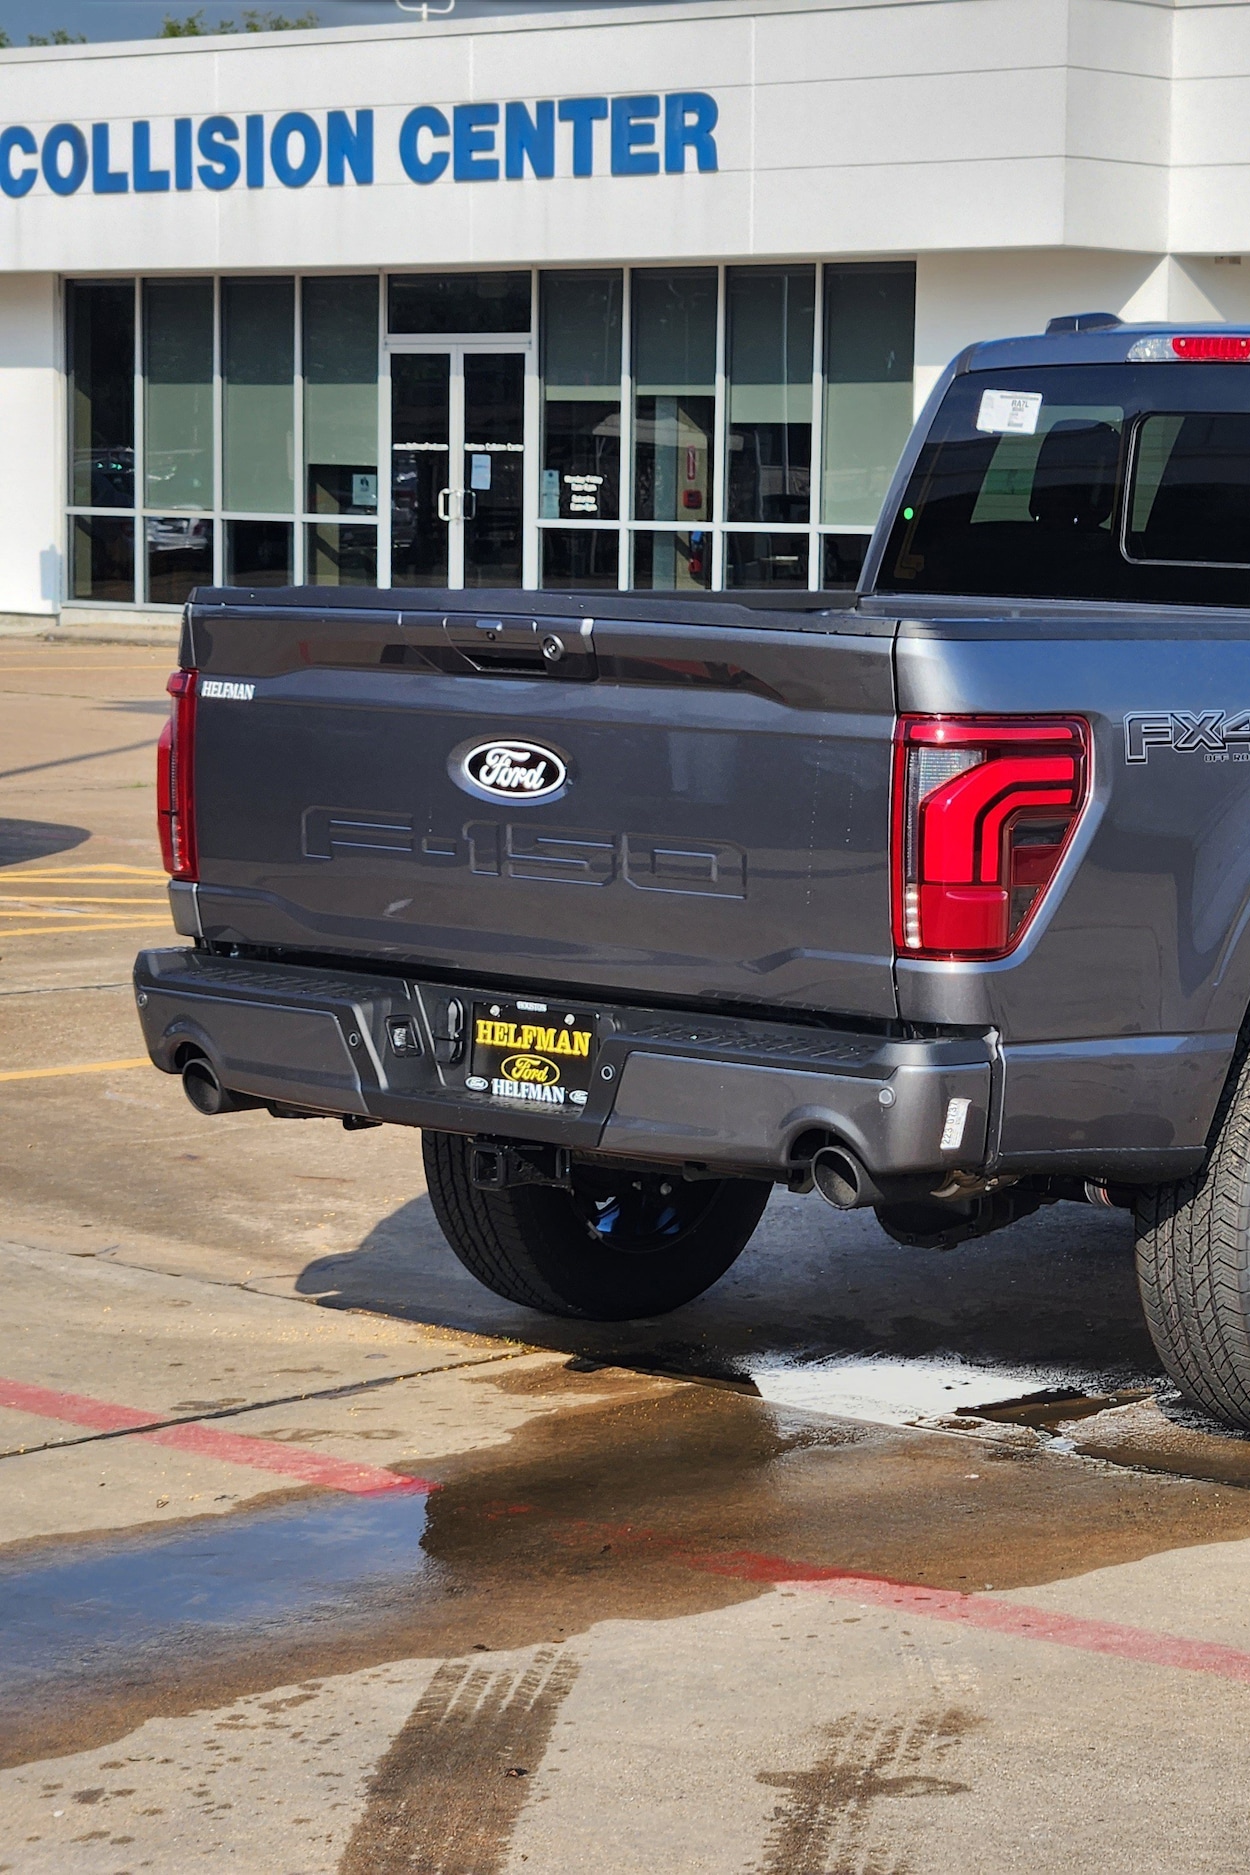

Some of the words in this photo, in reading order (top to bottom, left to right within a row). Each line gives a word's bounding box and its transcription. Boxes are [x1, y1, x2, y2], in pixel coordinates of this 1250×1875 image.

[0, 108, 375, 198] COLLISION
[398, 91, 719, 184] CENTER
[201, 681, 256, 700] HELFMAN
[479, 747, 547, 790] Ford
[1204, 753, 1229, 762] OFF
[301, 806, 748, 899] F-150
[475, 1019, 592, 1057] HELFMAN
[511, 1057, 550, 1082] Ford
[491, 1078, 565, 1104] HELFMAN
